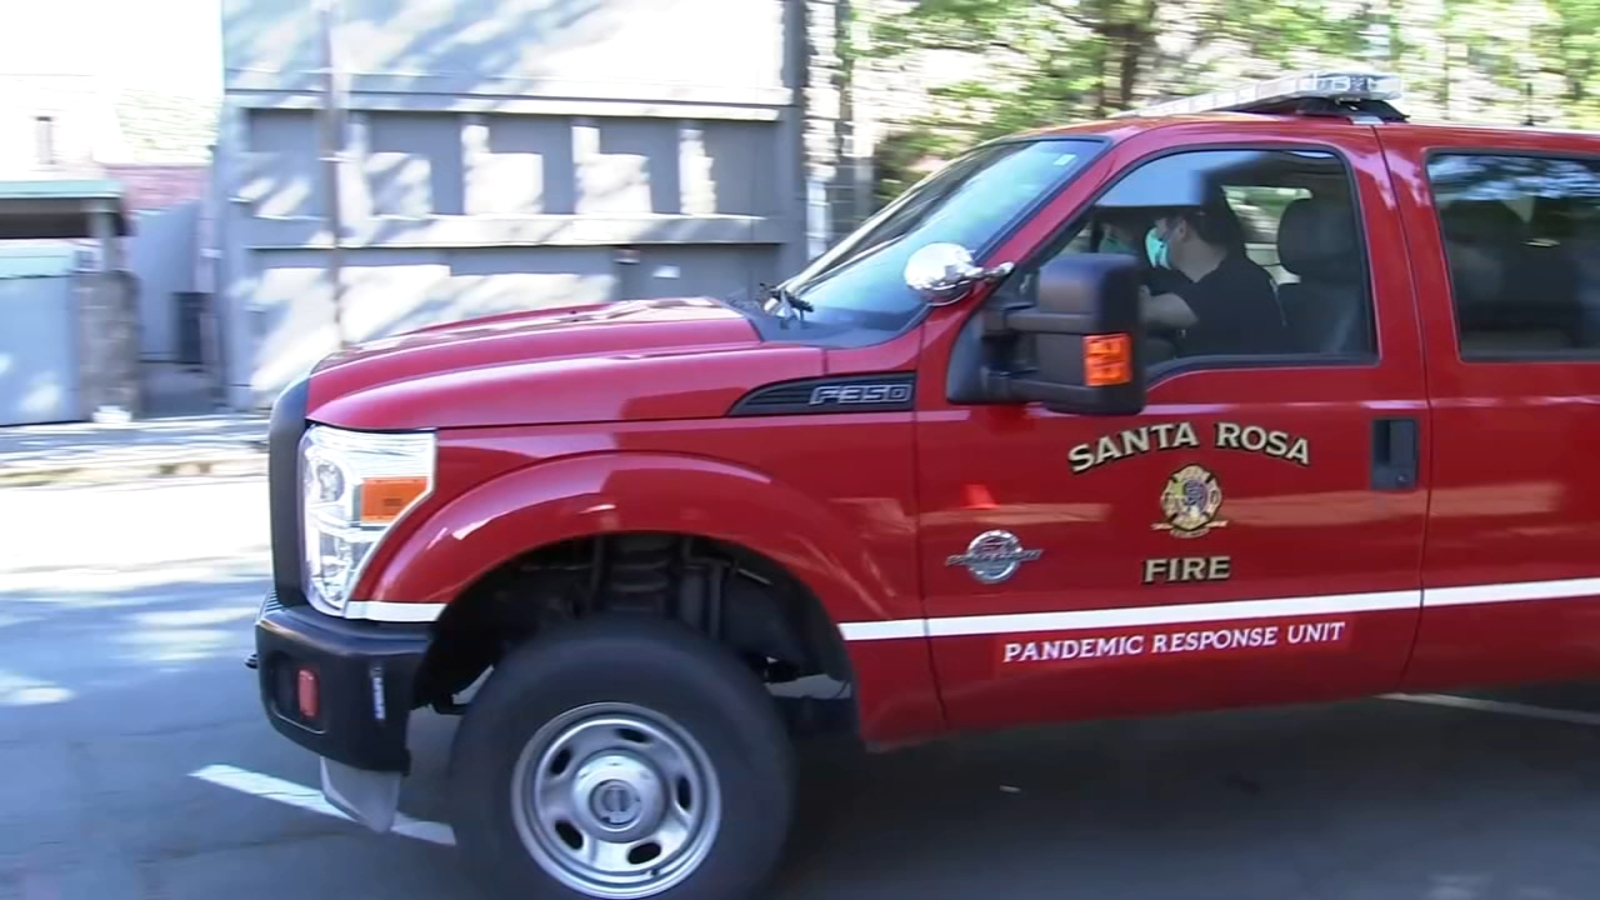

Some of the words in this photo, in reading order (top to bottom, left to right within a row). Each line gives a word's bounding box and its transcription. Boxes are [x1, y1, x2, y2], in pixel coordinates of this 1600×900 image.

[1067, 421, 1199, 474] SANTA
[1214, 421, 1311, 465] ROSA
[1142, 555, 1232, 585] FIRE
[1003, 635, 1144, 662] PANDEMIC
[1151, 626, 1278, 653] RESPONSE
[1287, 621, 1346, 644] UNIT
